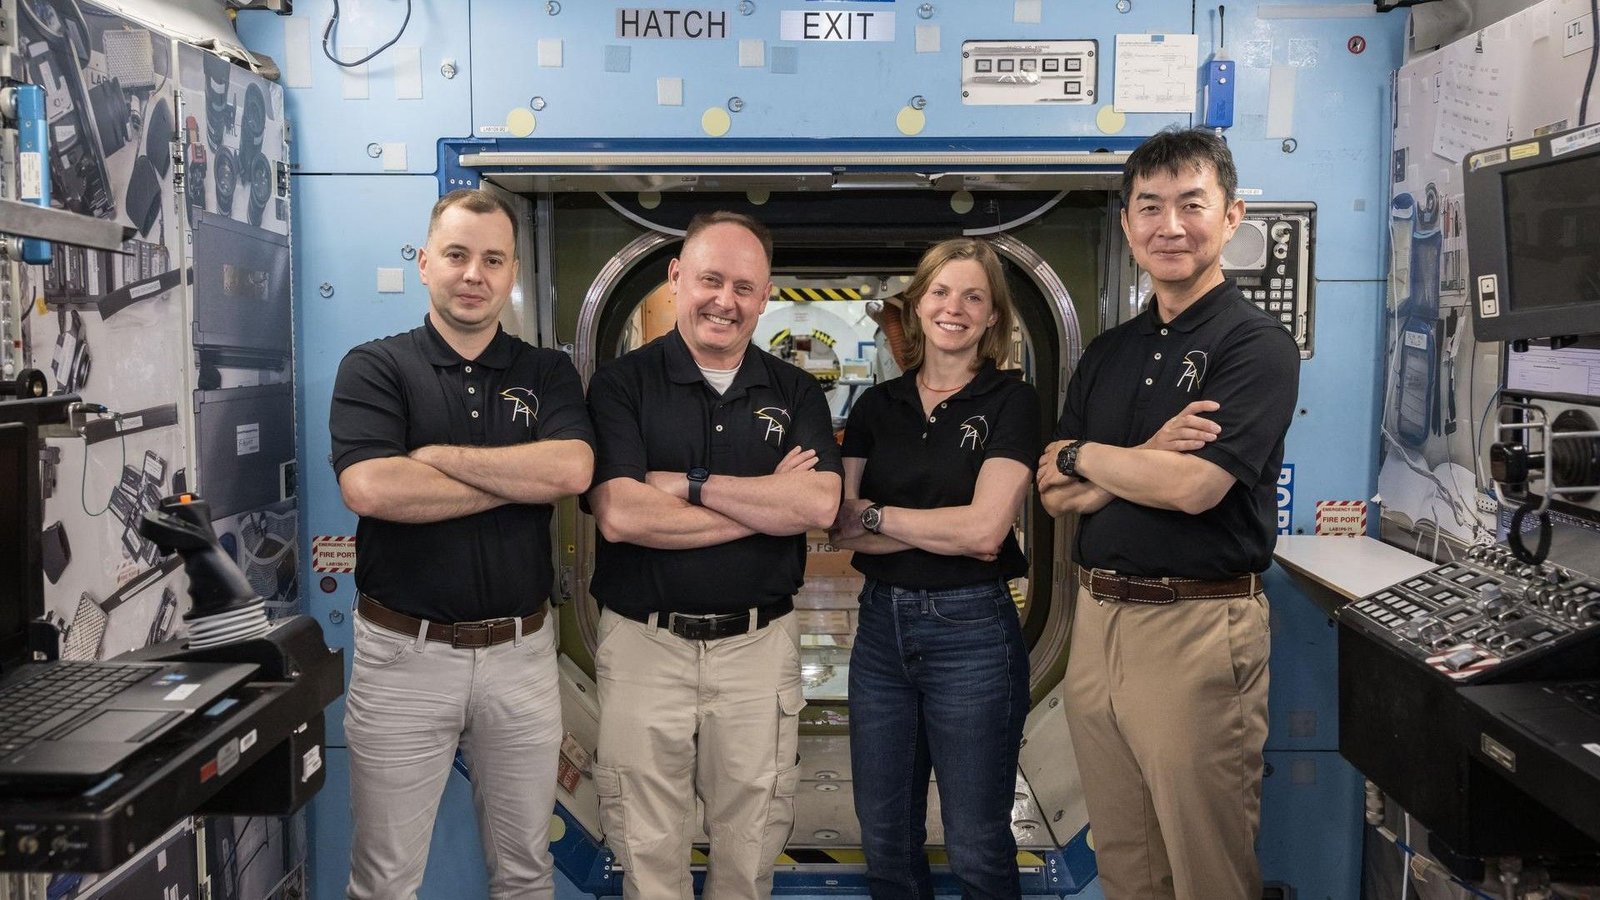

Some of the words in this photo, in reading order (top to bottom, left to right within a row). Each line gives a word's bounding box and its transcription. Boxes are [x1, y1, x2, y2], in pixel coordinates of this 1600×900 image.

[621, 9, 726, 38] HATCH
[804, 12, 875, 40] EXIT
[1567, 21, 1583, 39] LTL
